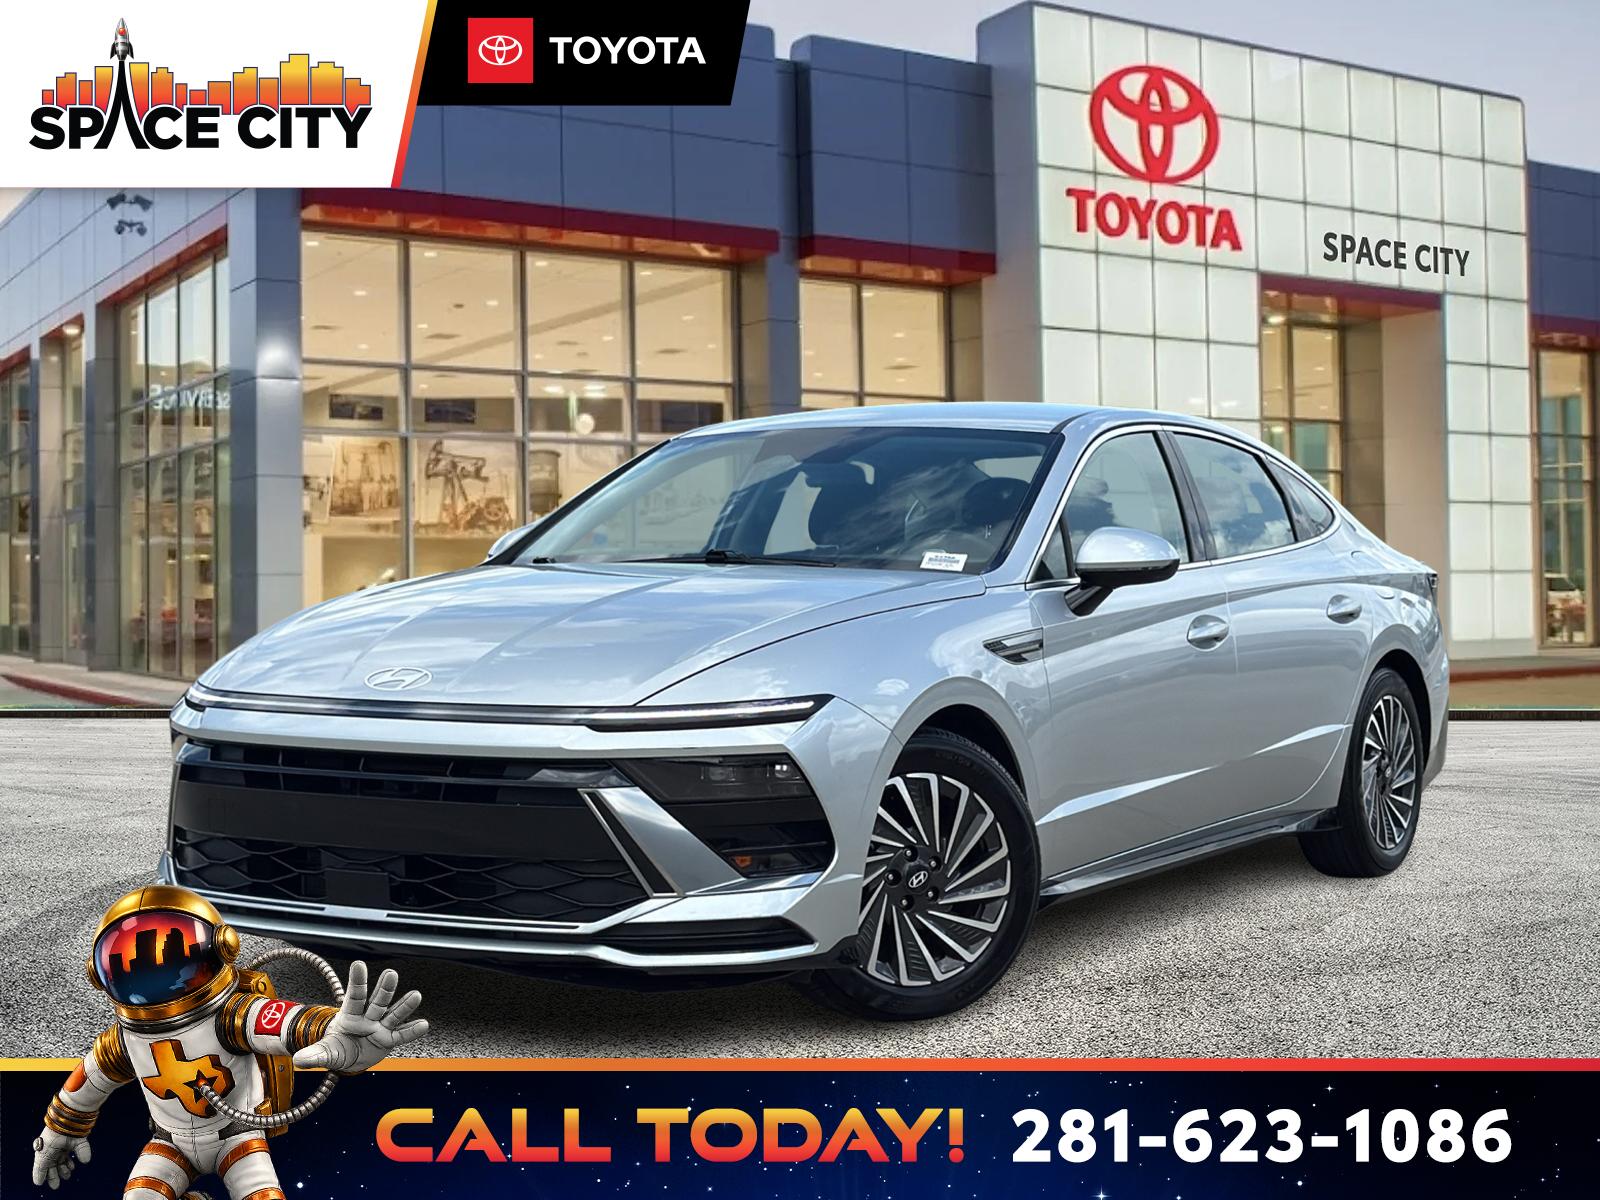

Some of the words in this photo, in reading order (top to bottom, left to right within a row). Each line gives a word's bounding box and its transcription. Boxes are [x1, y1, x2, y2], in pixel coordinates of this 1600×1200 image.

[1065, 187, 1242, 252] TOYOTA
[1323, 232, 1407, 270] SPACE
[1414, 244, 1470, 277] CITY
